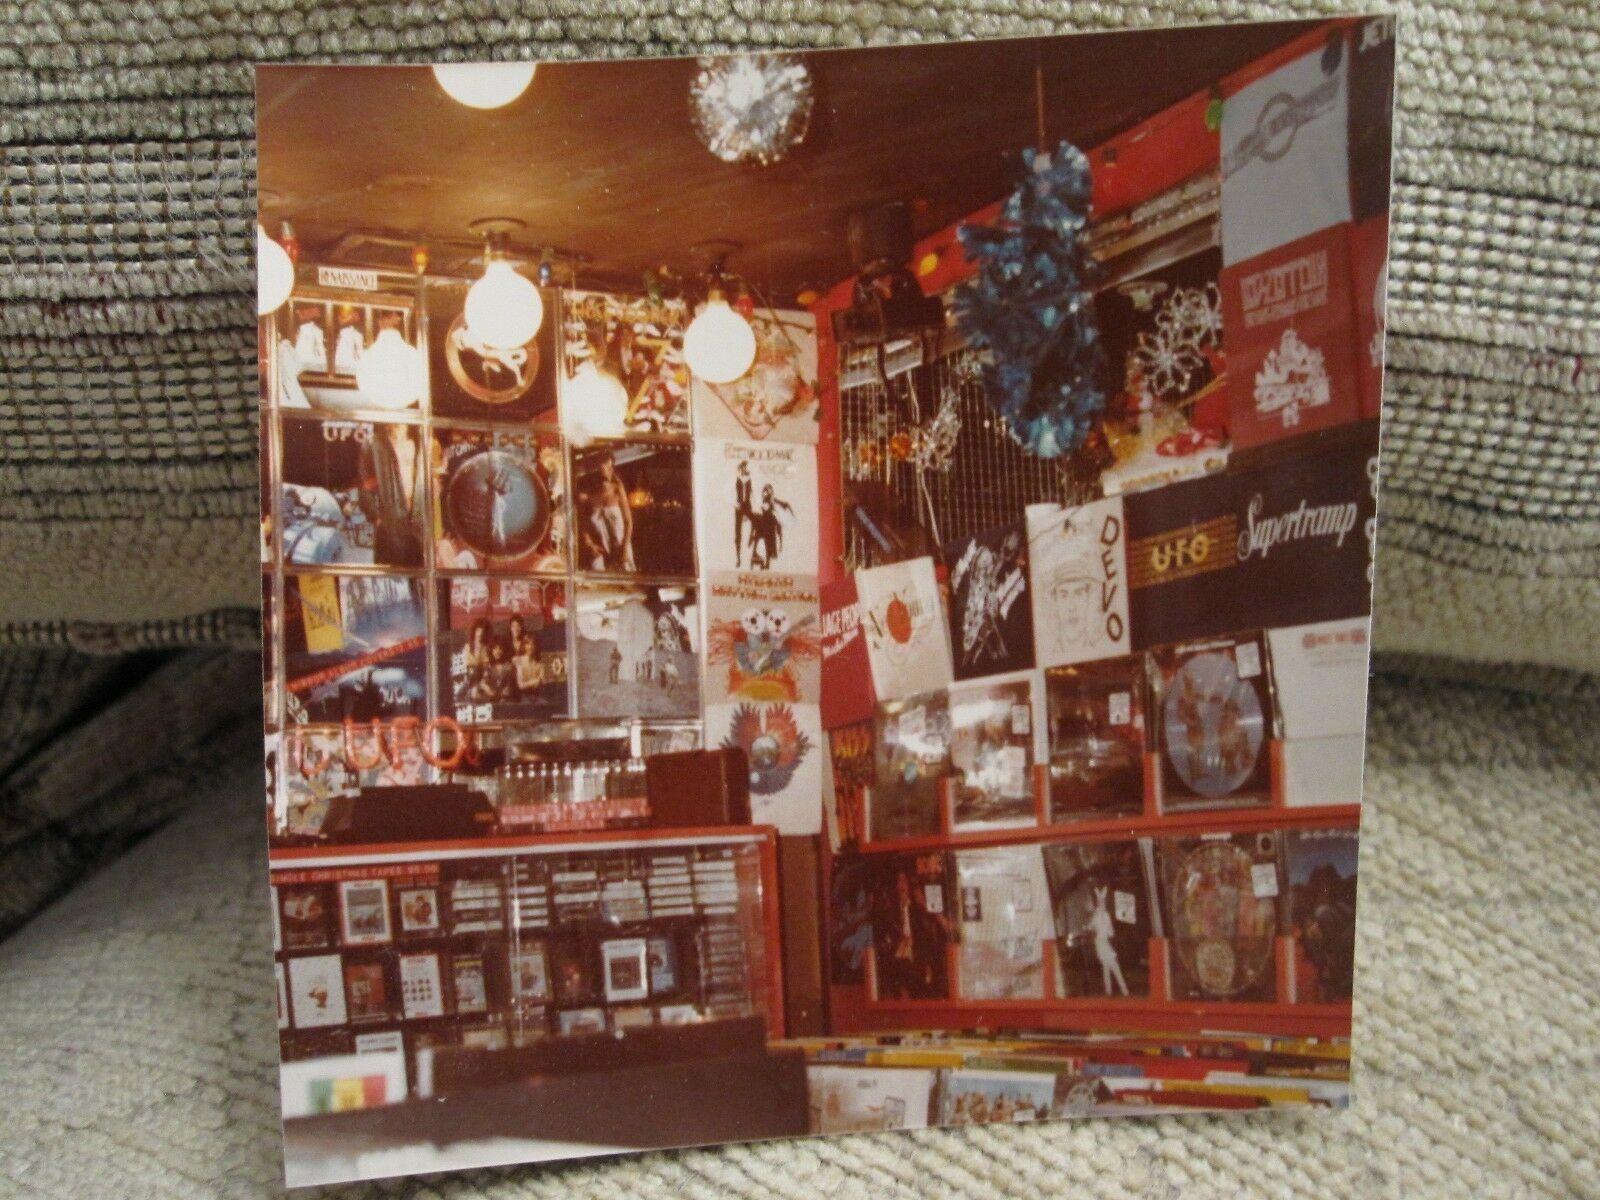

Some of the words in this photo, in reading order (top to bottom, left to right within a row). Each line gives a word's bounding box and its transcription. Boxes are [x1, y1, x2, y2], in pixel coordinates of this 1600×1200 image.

[1151, 533, 1214, 573] UFO
[1236, 494, 1358, 560] Supertramp
[1099, 514, 1125, 643] DEVO
